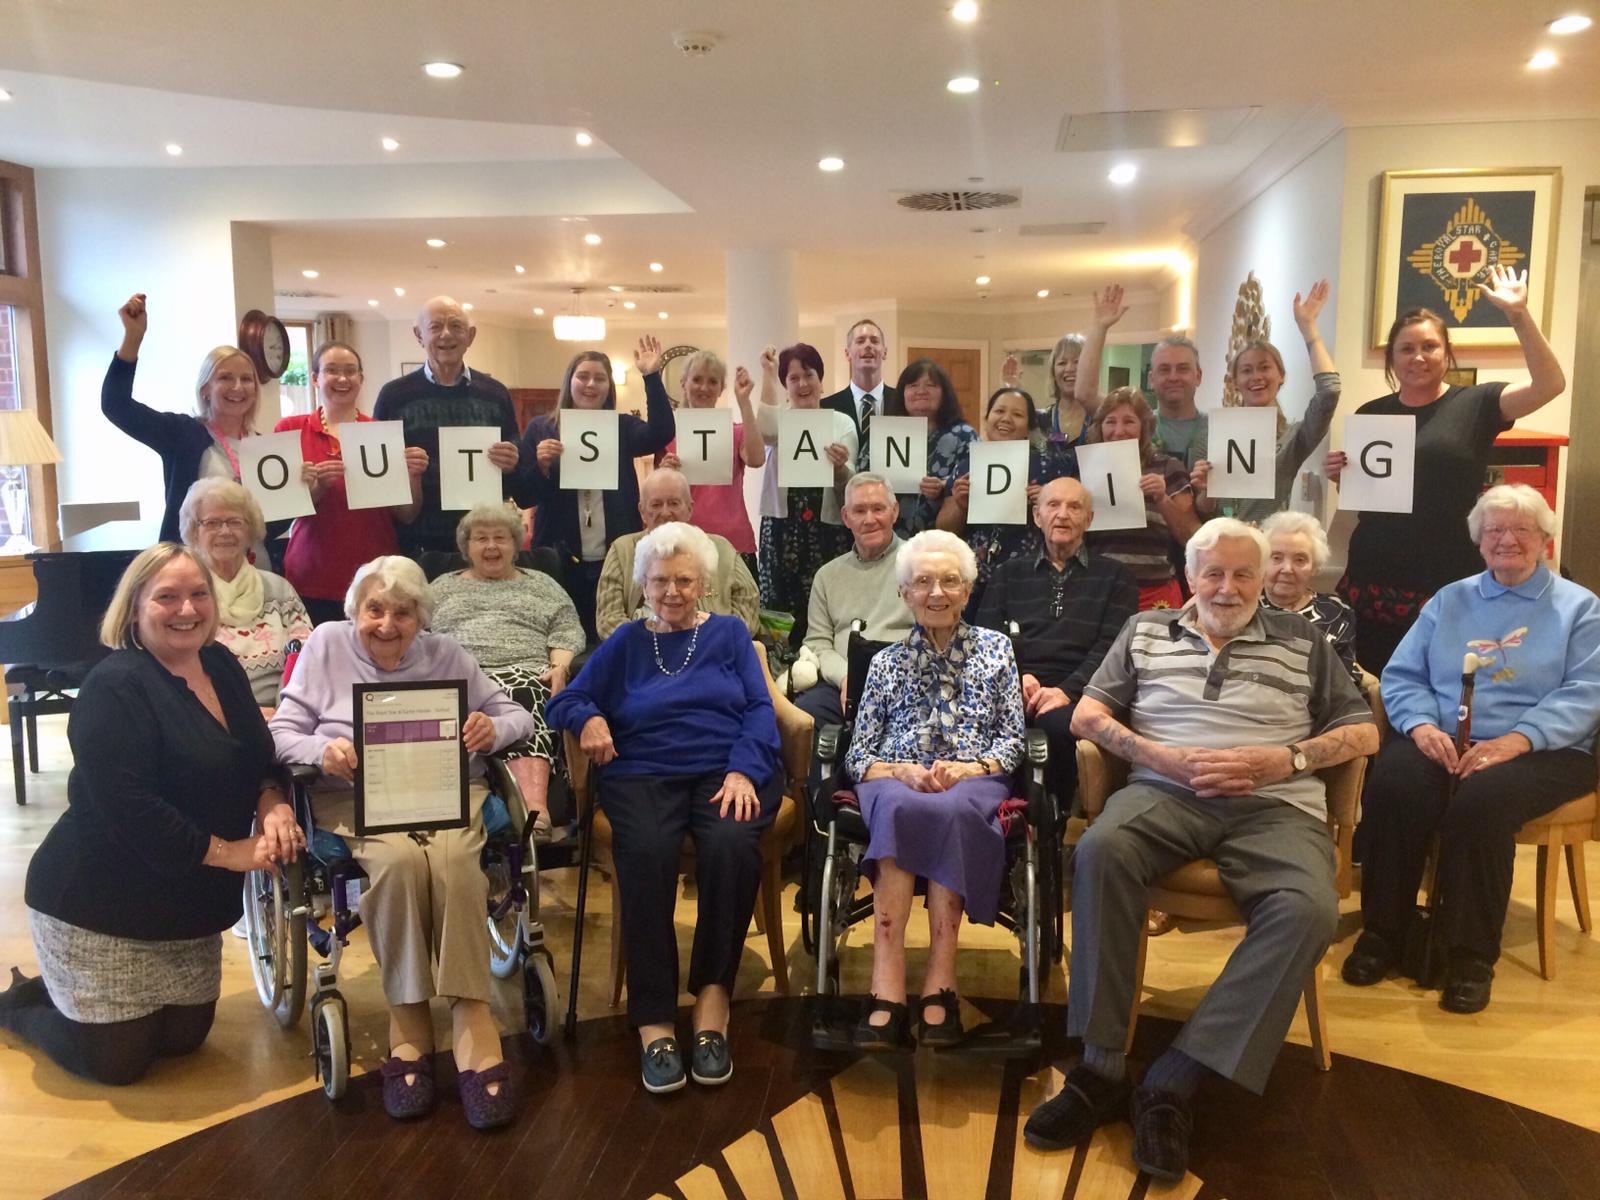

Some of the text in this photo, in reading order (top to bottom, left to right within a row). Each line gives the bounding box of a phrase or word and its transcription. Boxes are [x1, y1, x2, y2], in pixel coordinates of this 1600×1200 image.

[1455, 225, 1482, 236] STAR
[359, 443, 389, 479] U
[579, 430, 600, 463] S
[692, 429, 717, 462] T
[792, 429, 819, 461] A
[886, 436, 911, 468] N
[1226, 438, 1256, 475] N
[1359, 440, 1393, 479] G
[256, 455, 289, 491] O
[457, 449, 483, 481] T
[986, 464, 1012, 496] D
[1106, 473, 1116, 507] I
